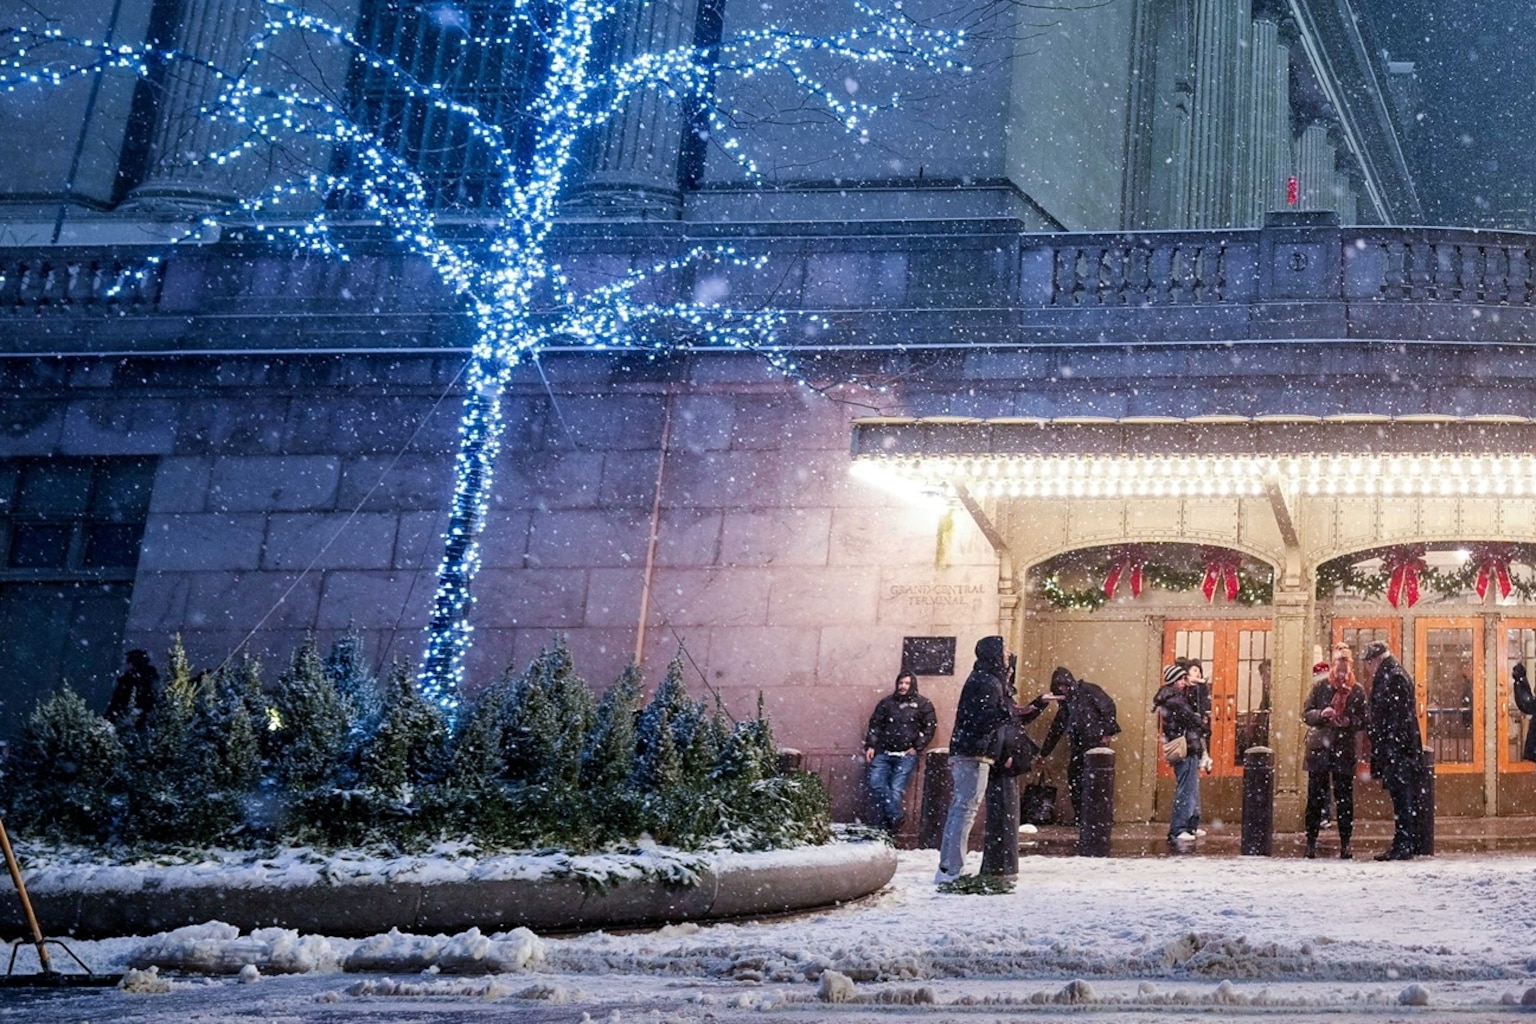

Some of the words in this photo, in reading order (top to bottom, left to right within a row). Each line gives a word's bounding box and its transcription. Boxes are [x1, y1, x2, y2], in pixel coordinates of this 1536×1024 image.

[889, 584, 933, 595] GRAND
[934, 584, 985, 595] CENTRAL
[908, 596, 969, 606] TERMINAL
